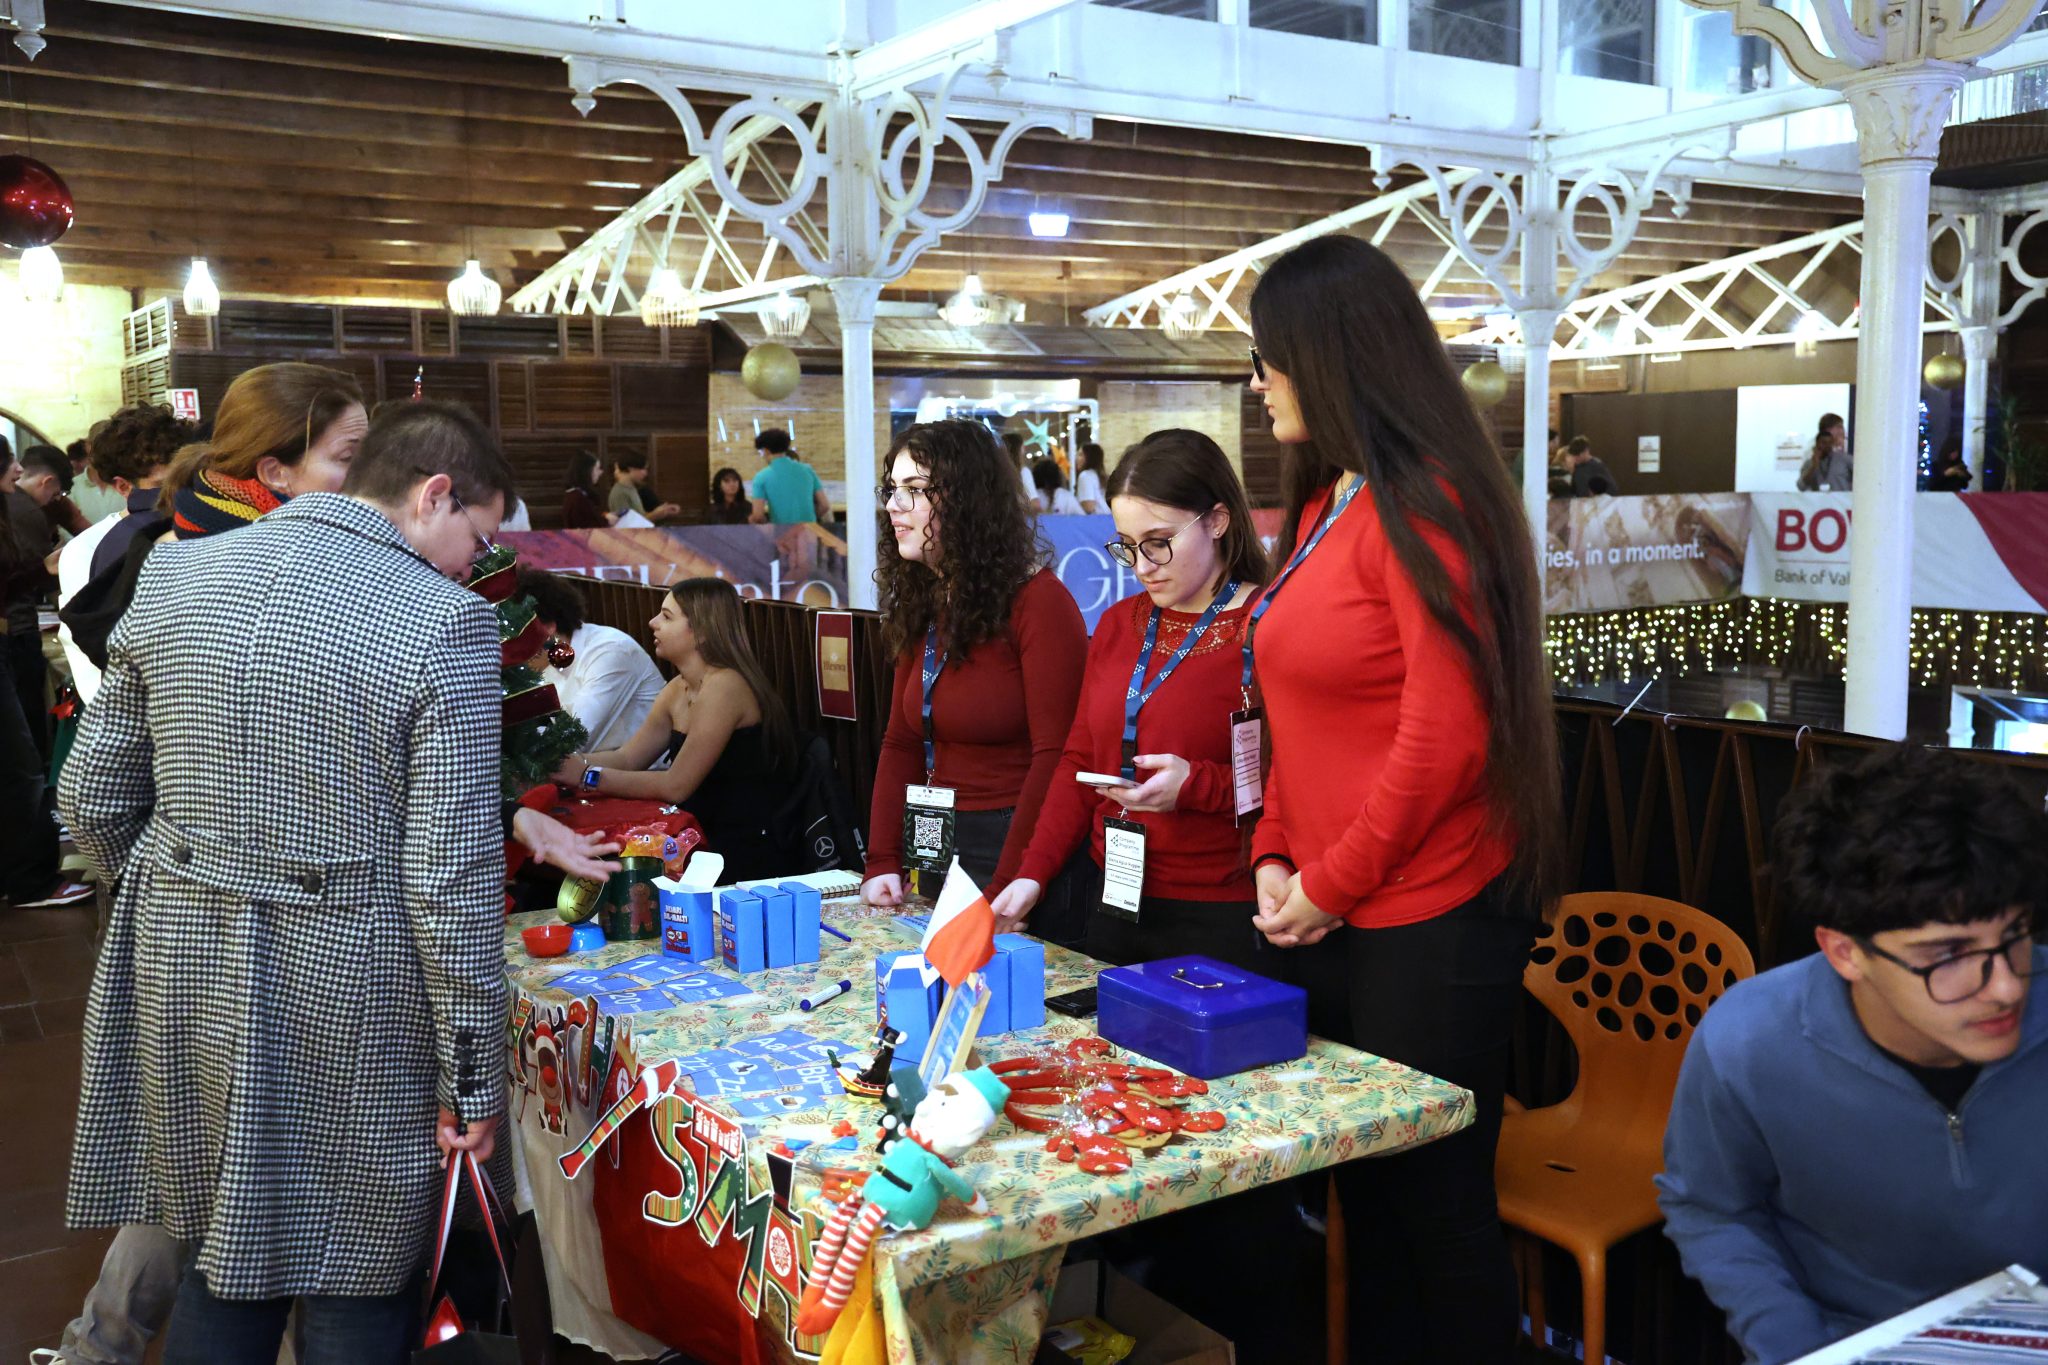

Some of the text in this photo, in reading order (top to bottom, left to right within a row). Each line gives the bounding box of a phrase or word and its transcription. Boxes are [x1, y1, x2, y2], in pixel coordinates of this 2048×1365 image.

[1776, 508, 1852, 554] BO
[1585, 542, 1603, 566] in
[1608, 547, 1621, 565] a
[1626, 538, 1705, 563] moment.
[1775, 569, 1807, 584] Bank
[1810, 569, 1826, 585] of
[563, 974, 599, 984] 19
[667, 978, 708, 991] 2
[609, 992, 642, 1006] 20
[748, 1037, 788, 1051] Aa
[797, 1065, 831, 1084] Bb
